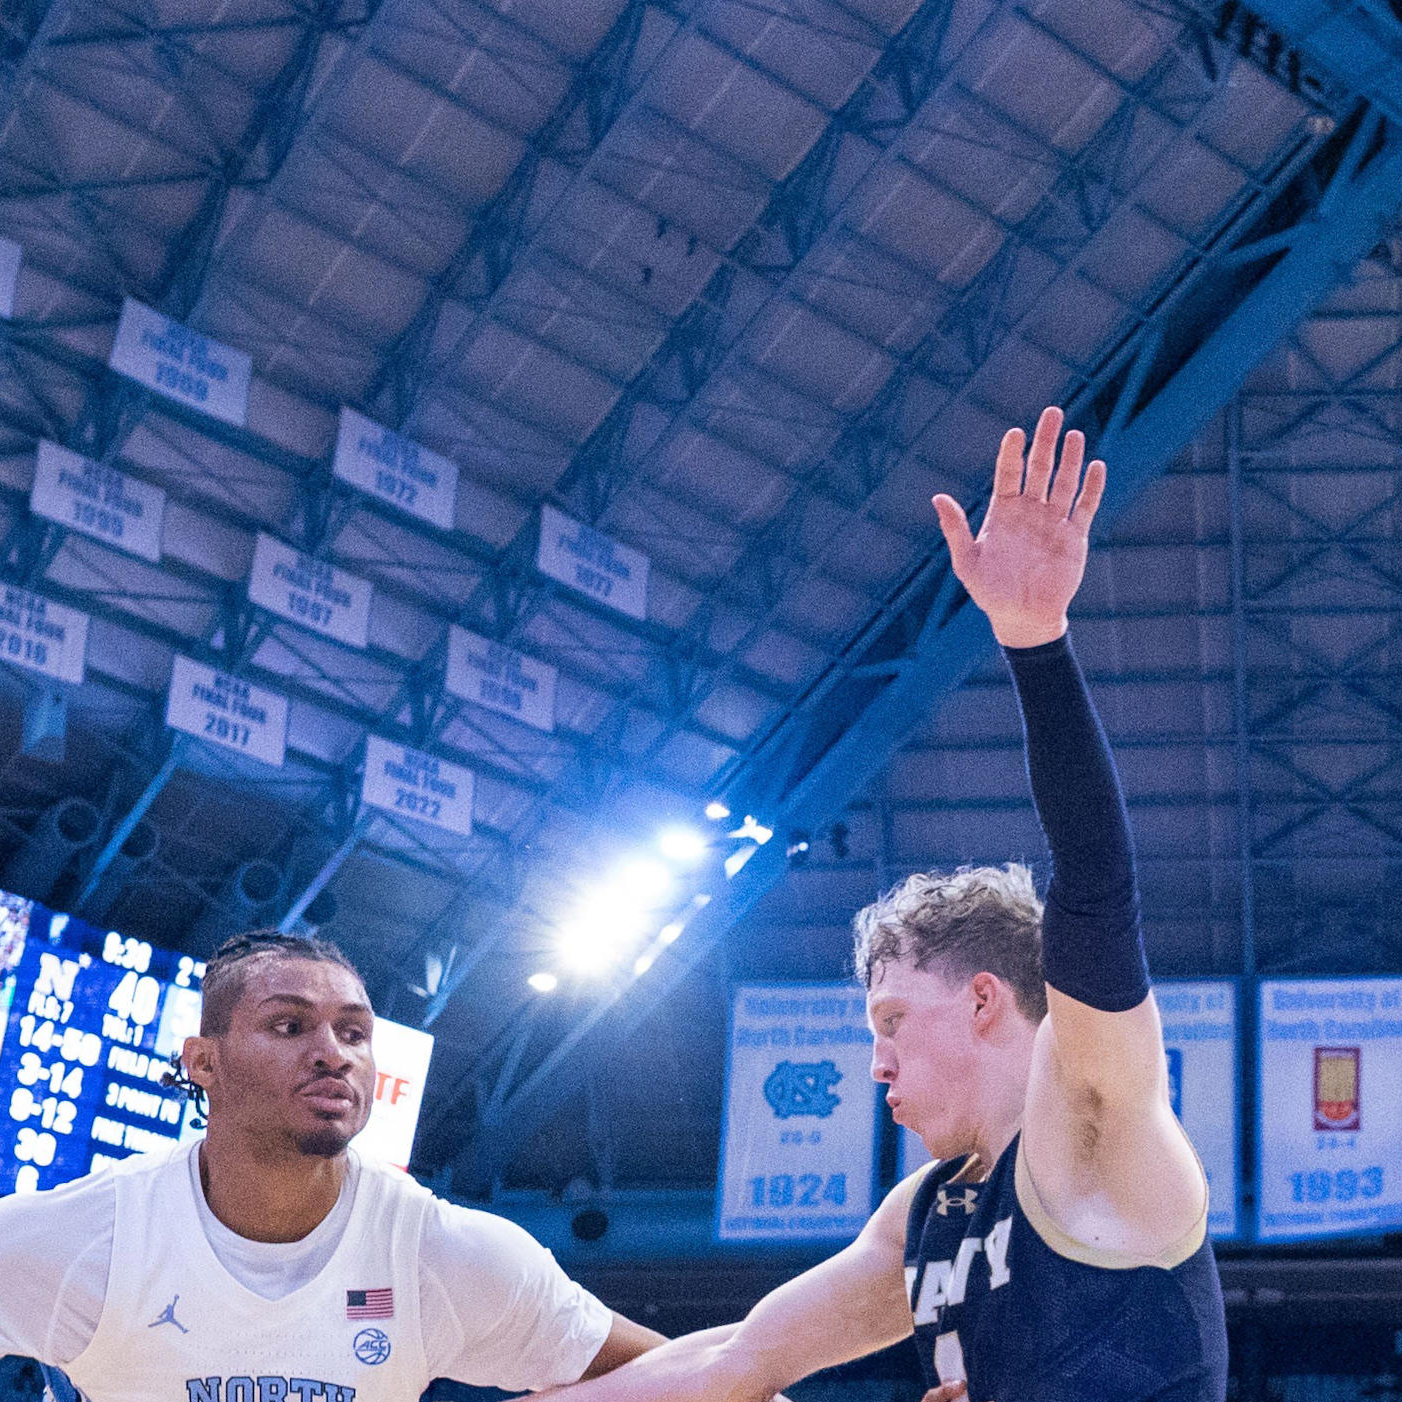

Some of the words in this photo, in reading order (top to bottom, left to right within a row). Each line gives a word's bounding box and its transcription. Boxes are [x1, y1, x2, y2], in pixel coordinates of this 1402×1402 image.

[190, 681, 228, 710] FINAL
[231, 696, 266, 724] FOUR
[202, 709, 250, 748] 2017
[394, 783, 441, 821] 2022
[108, 970, 160, 1026] 40
[17, 1052, 84, 1099] 3-14
[375, 1072, 410, 1105] TF
[748, 1173, 847, 1208] 1924
[1287, 1166, 1384, 1203] 1993
[358, 1339, 387, 1351] ACC
